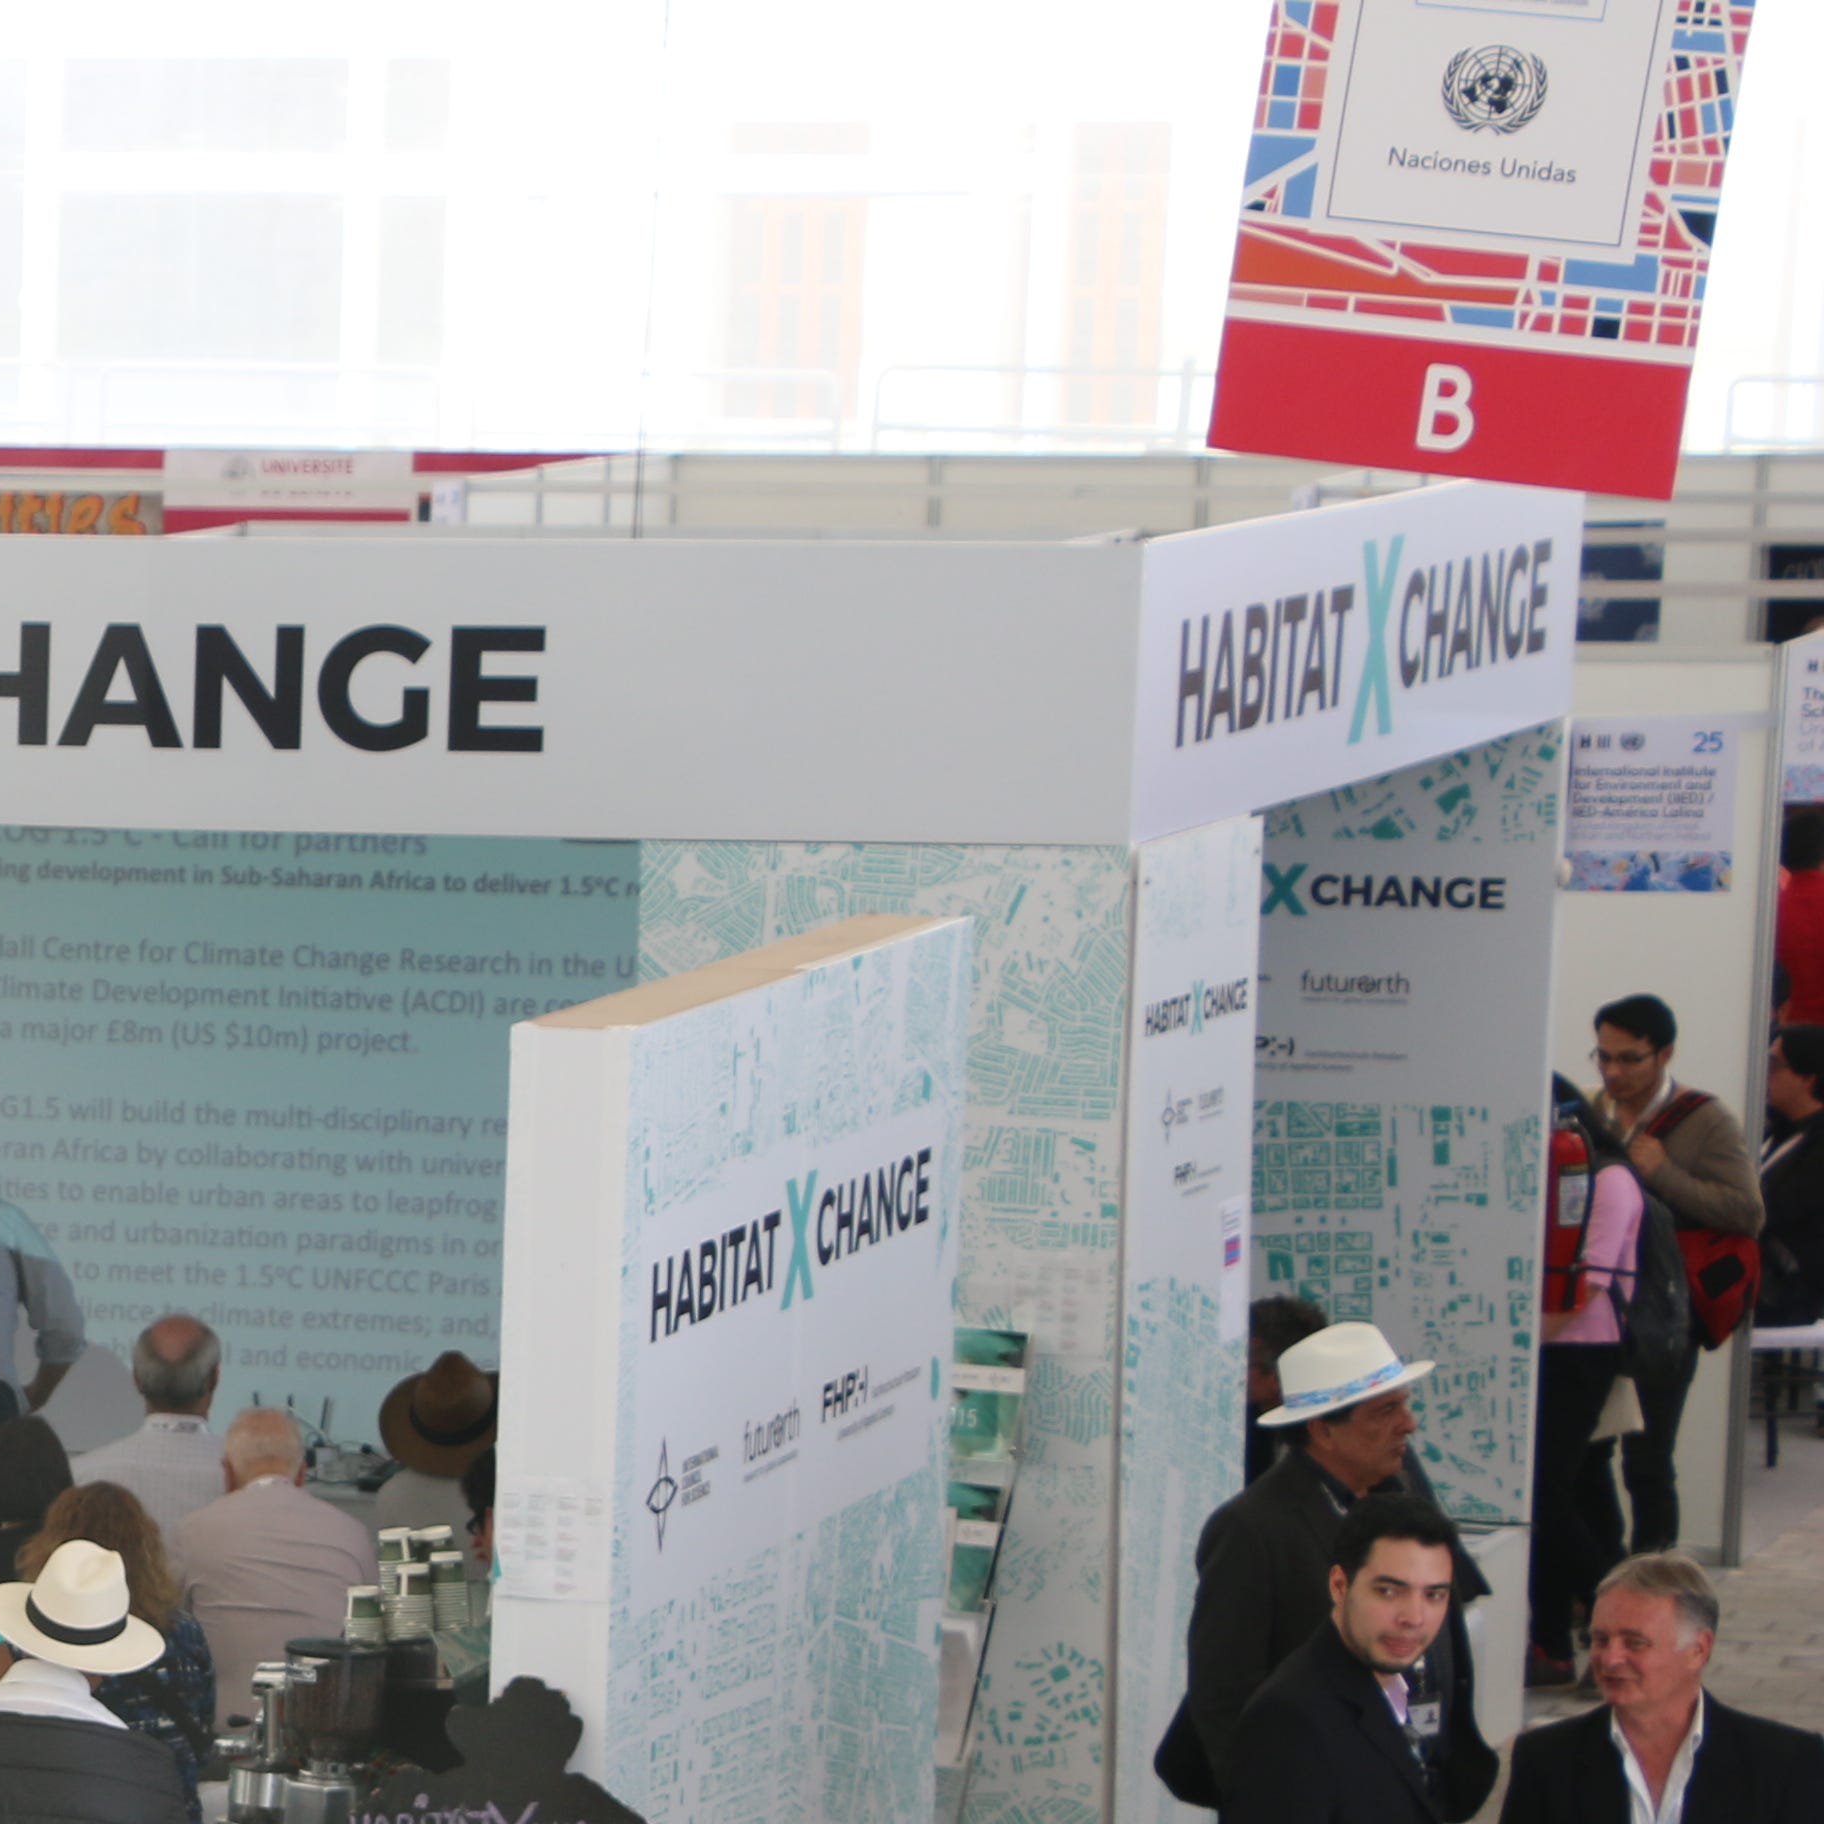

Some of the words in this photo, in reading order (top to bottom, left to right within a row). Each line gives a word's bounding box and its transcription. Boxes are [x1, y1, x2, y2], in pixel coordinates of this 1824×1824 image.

[1388, 146, 1492, 178] Naciones
[1499, 155, 1577, 184] Unidas
[1415, 362, 1474, 452] B
[1175, 583, 1355, 748] HABITAT
[1347, 533, 1406, 744] X
[1399, 536, 1553, 689] CHANGE
[1693, 731, 1724, 752] 25
[1574, 766, 1659, 777] International
[1596, 780, 1682, 791] Environment
[1685, 780, 1713, 791] and
[294, 833, 427, 856] partners
[36, 858, 186, 886] development
[193, 863, 213, 884] in
[220, 864, 363, 889] Sub-Saharan
[370, 868, 435, 892] Africa
[443, 873, 467, 893] to
[474, 869, 552, 896] deliver
[1310, 874, 1506, 910] CHANGE
[43, 936, 131, 964] Centre
[138, 938, 175, 965] for
[184, 940, 285, 968] Climate
[292, 944, 391, 976] Change
[399, 947, 521, 977] Research
[528, 951, 553, 976] in
[561, 952, 606, 979] the
[92, 977, 270, 1010] Development
[279, 985, 393, 1013] Initiative
[401, 988, 485, 1017] (ACDI)
[494, 997, 537, 1017] are
[1145, 994, 1190, 1037] HABITAT
[1190, 979, 1204, 1036] X
[1204, 976, 1249, 1020] CHANGE
[20, 1017, 98, 1048] major
[106, 1019, 164, 1045] £8m
[172, 1019, 216, 1048] (US
[225, 1020, 309, 1053] $10m)
[316, 1026, 420, 1057] project.
[68, 1095, 113, 1122] will
[121, 1097, 185, 1125] build
[194, 1101, 237, 1127] the
[244, 1103, 473, 1140] multi-disciplinary
[52, 1136, 128, 1164] Africa
[136, 1139, 167, 1168] by
[174, 1141, 348, 1178] collaborating
[354, 1150, 414, 1176] with
[57, 1178, 83, 1201] to
[92, 1176, 180, 1205] enable
[189, 1182, 264, 1210] urban
[273, 1189, 344, 1212] areas
[353, 1191, 380, 1214] to
[386, 1190, 497, 1222] leapfrog
[68, 1219, 116, 1243] and
[124, 1221, 288, 1249] urbanization
[297, 1229, 434, 1258] paradigms
[442, 1235, 466, 1256] in
[649, 1208, 782, 1343] HABITAT
[780, 1169, 818, 1311] X
[817, 1147, 932, 1266] CHANGE
[73, 1259, 100, 1281] to
[107, 1262, 174, 1285] meet
[183, 1261, 227, 1286] the
[312, 1268, 420, 1294] UNFCCC
[427, 1271, 491, 1296] Paris
[198, 1301, 294, 1329] climate
[302, 1310, 432, 1338] extremes;
[439, 1314, 497, 1340] and,
[239, 1344, 287, 1368] and
[296, 1347, 424, 1372] economic
